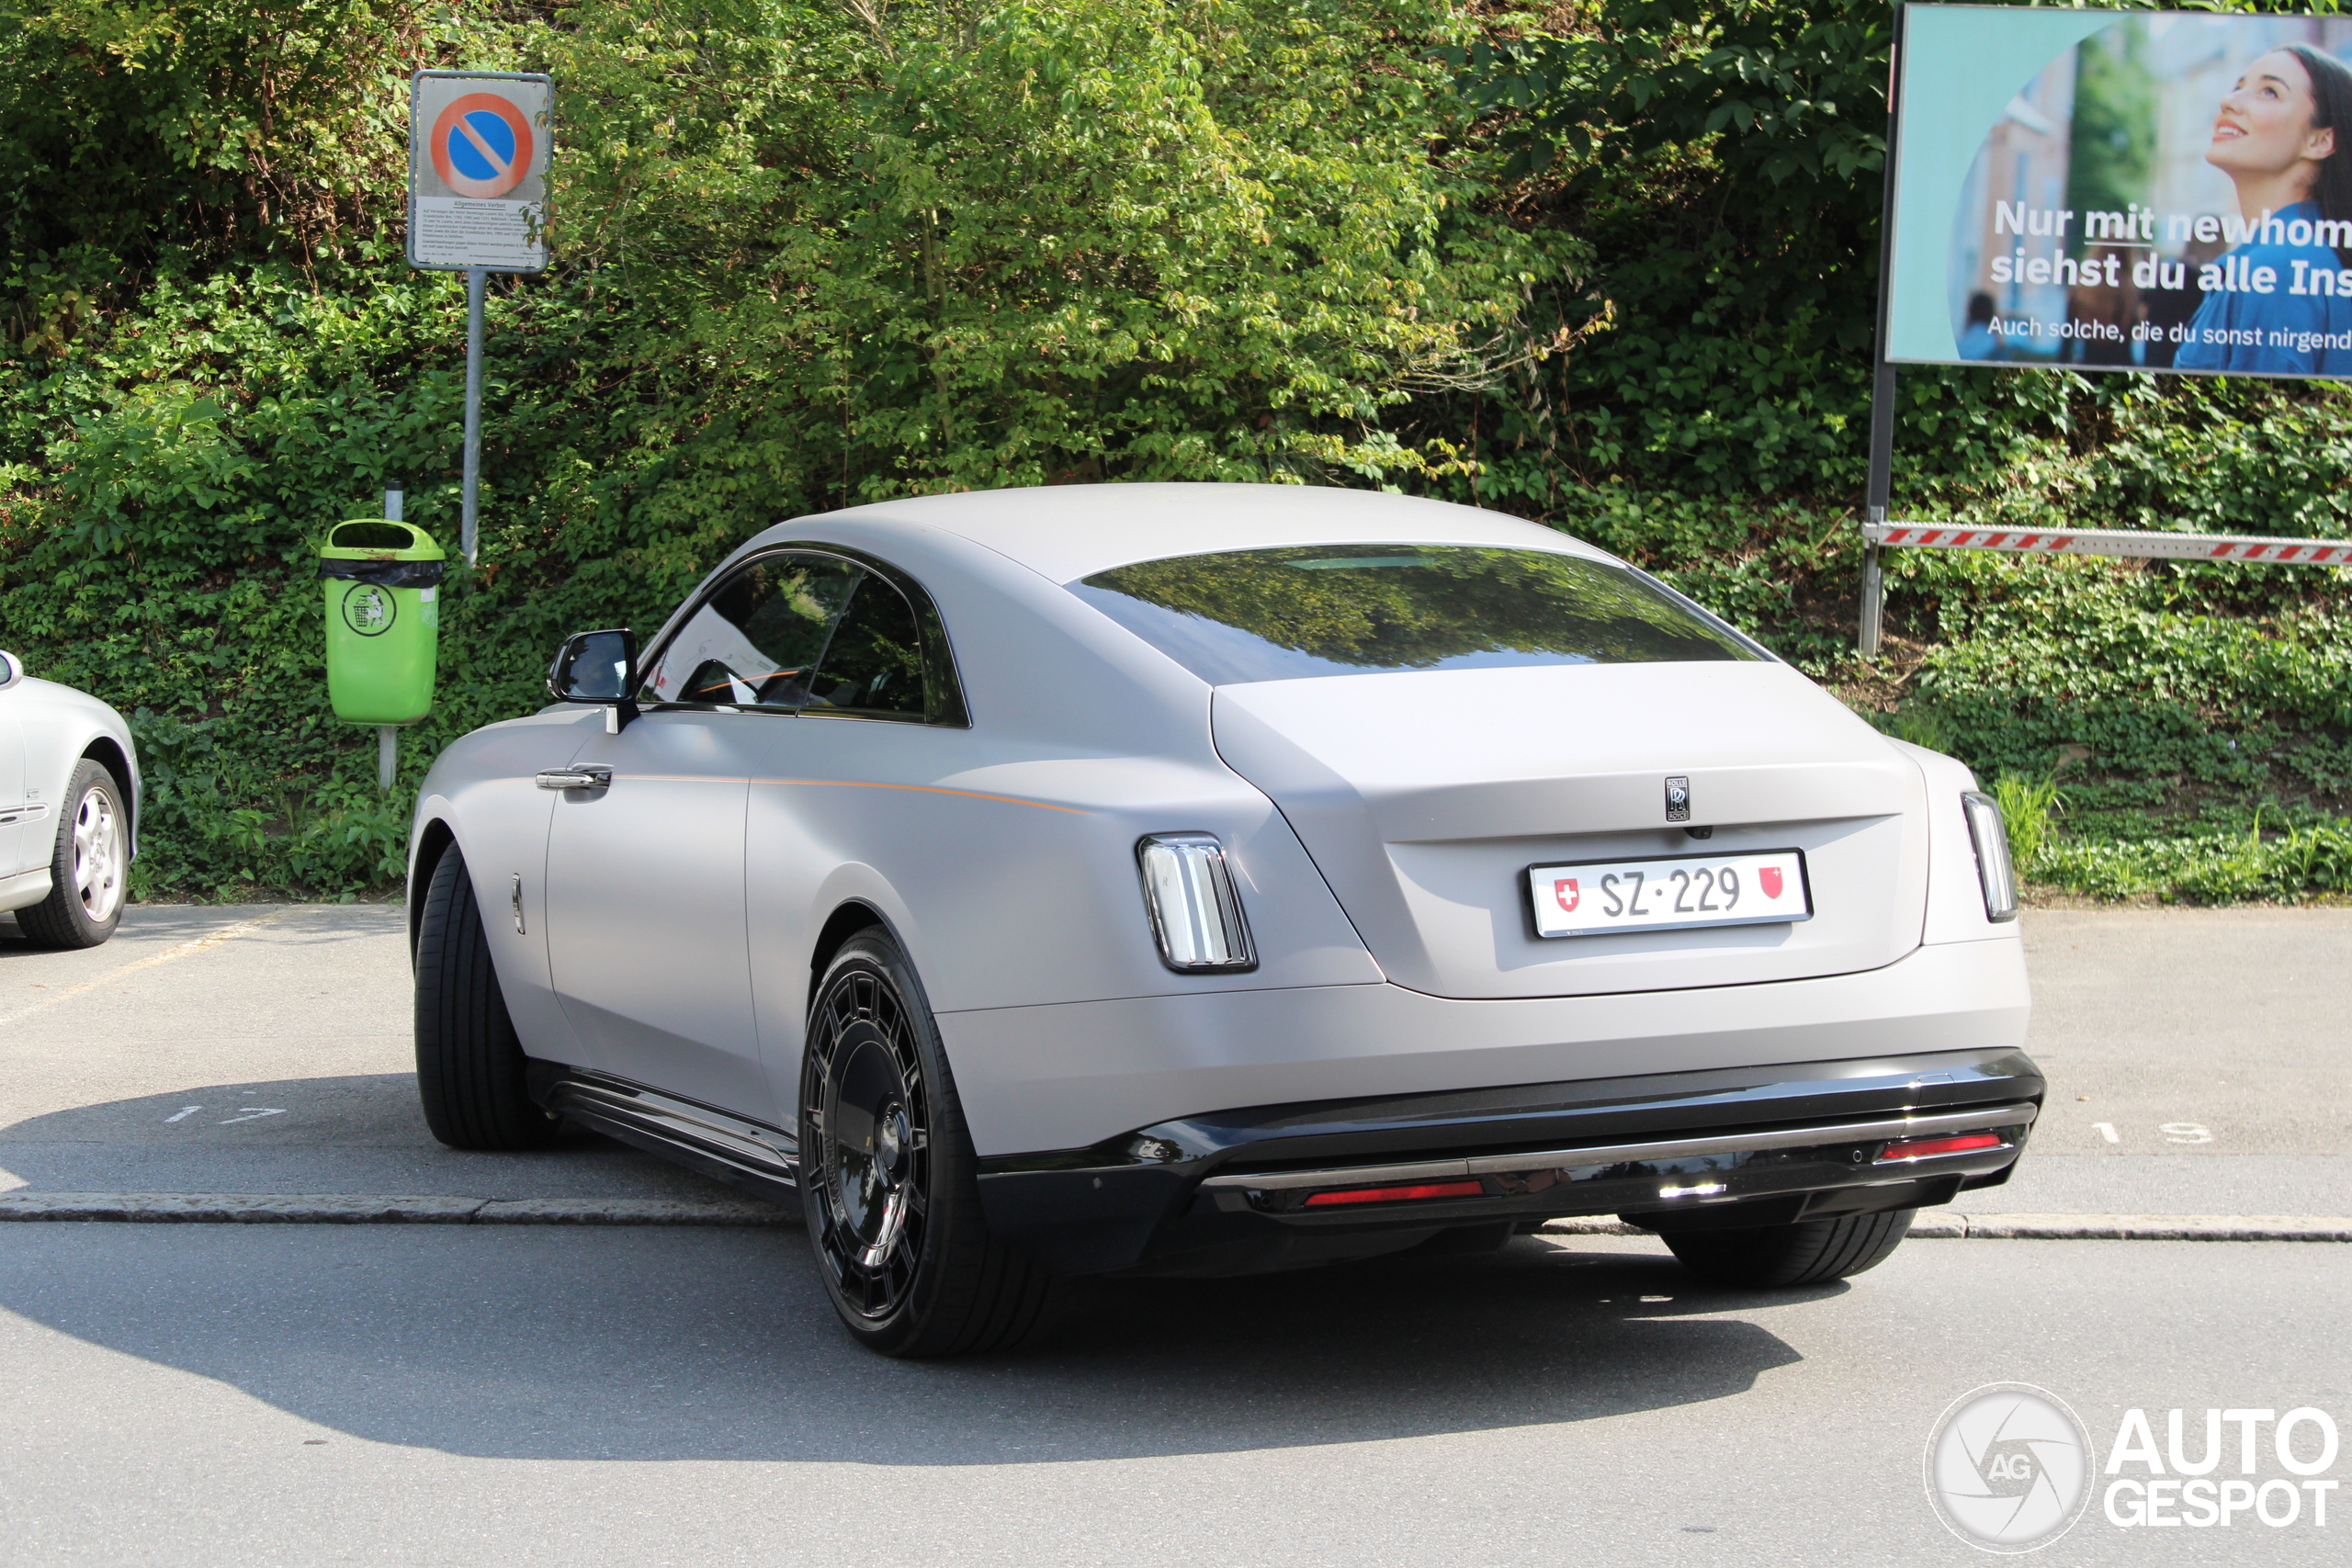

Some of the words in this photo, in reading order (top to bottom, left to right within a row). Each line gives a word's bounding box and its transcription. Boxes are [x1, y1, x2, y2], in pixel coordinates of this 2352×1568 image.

[454, 200, 486, 209] Allgemeines
[1995, 200, 2074, 238] Nur
[2084, 203, 2154, 240] mit
[2167, 209, 2352, 249] newhom
[1990, 247, 2120, 288] siehst
[2132, 252, 2185, 290] du
[2198, 255, 2278, 293] alle
[2289, 259, 2352, 298] Ins
[1987, 315, 2041, 336] Auch
[2049, 318, 2125, 344] solche,
[2132, 321, 2164, 342] die
[2168, 321, 2197, 344] du
[2202, 327, 2263, 346] sonst
[2268, 326, 2352, 354] nirgend
